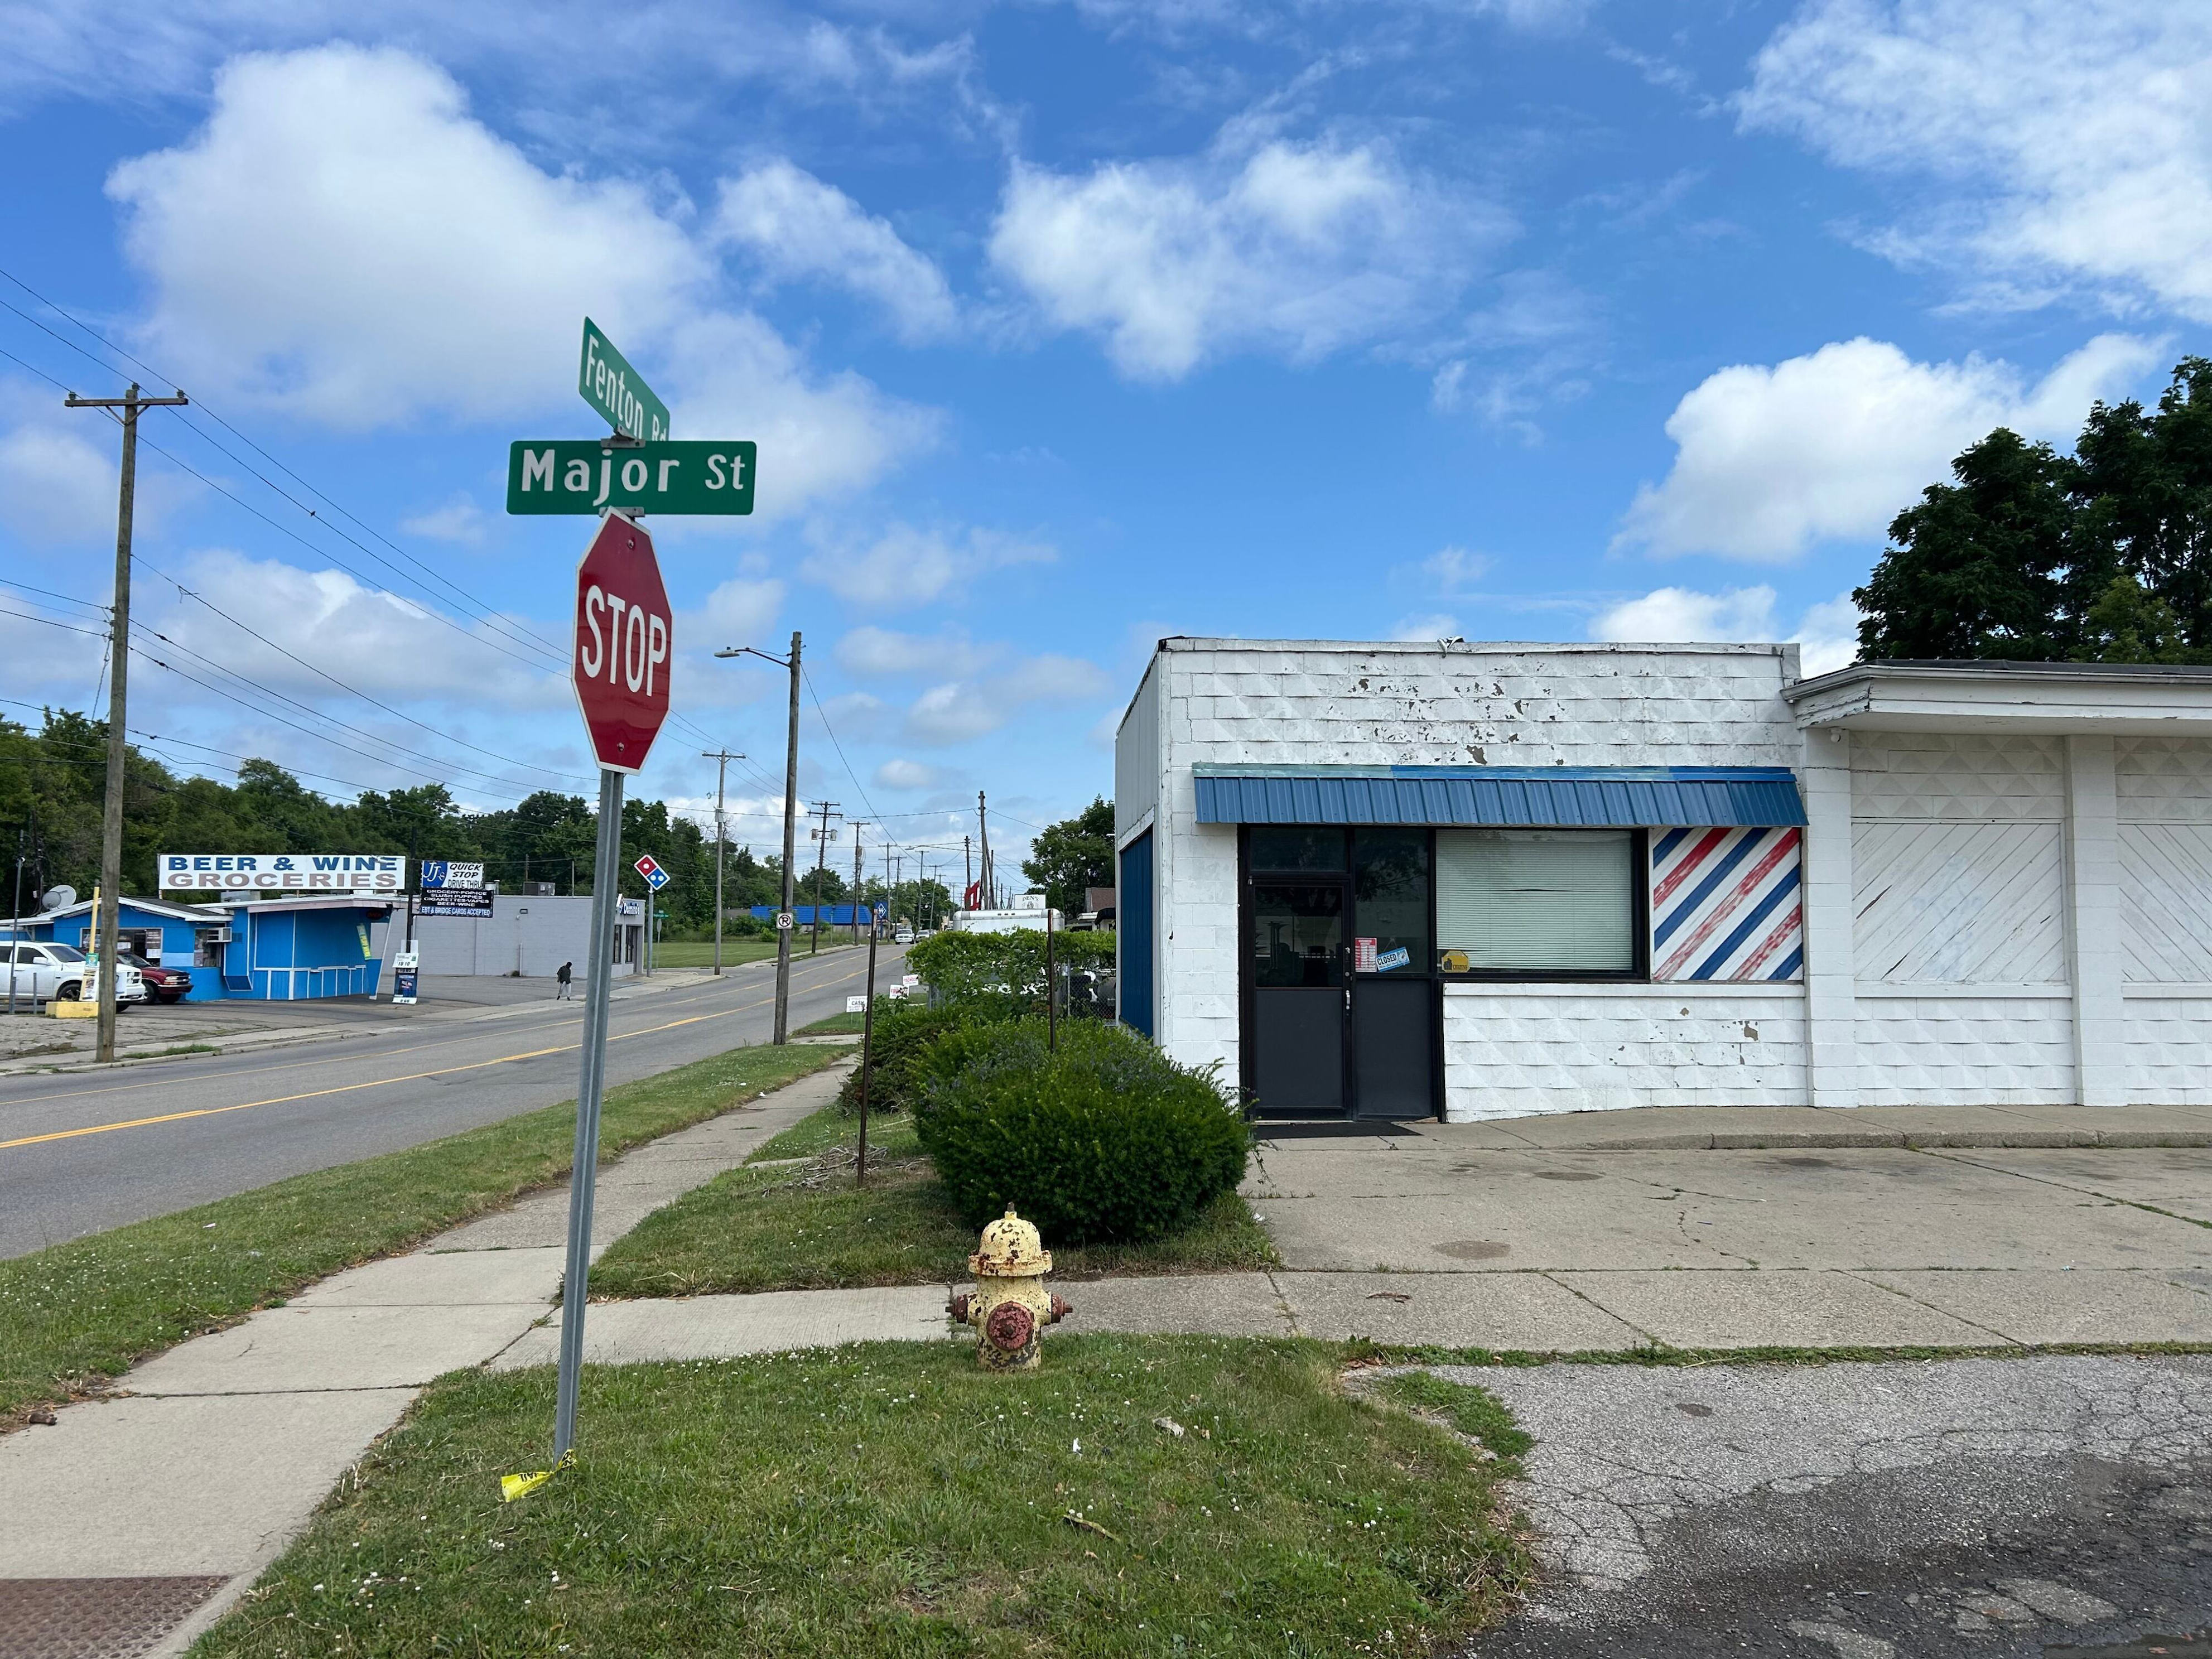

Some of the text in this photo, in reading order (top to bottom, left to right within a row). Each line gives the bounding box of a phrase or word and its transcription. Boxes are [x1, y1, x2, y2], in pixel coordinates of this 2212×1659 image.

[586, 333, 643, 440] Fenton
[522, 448, 745, 507] Major St
[582, 585, 667, 697] STOP
[168, 857, 397, 871] BEER & WINE
[167, 873, 397, 888] GROCERIES
[448, 879, 482, 889] DRIVE THRU
[1377, 953, 1397, 965] CLOSED
